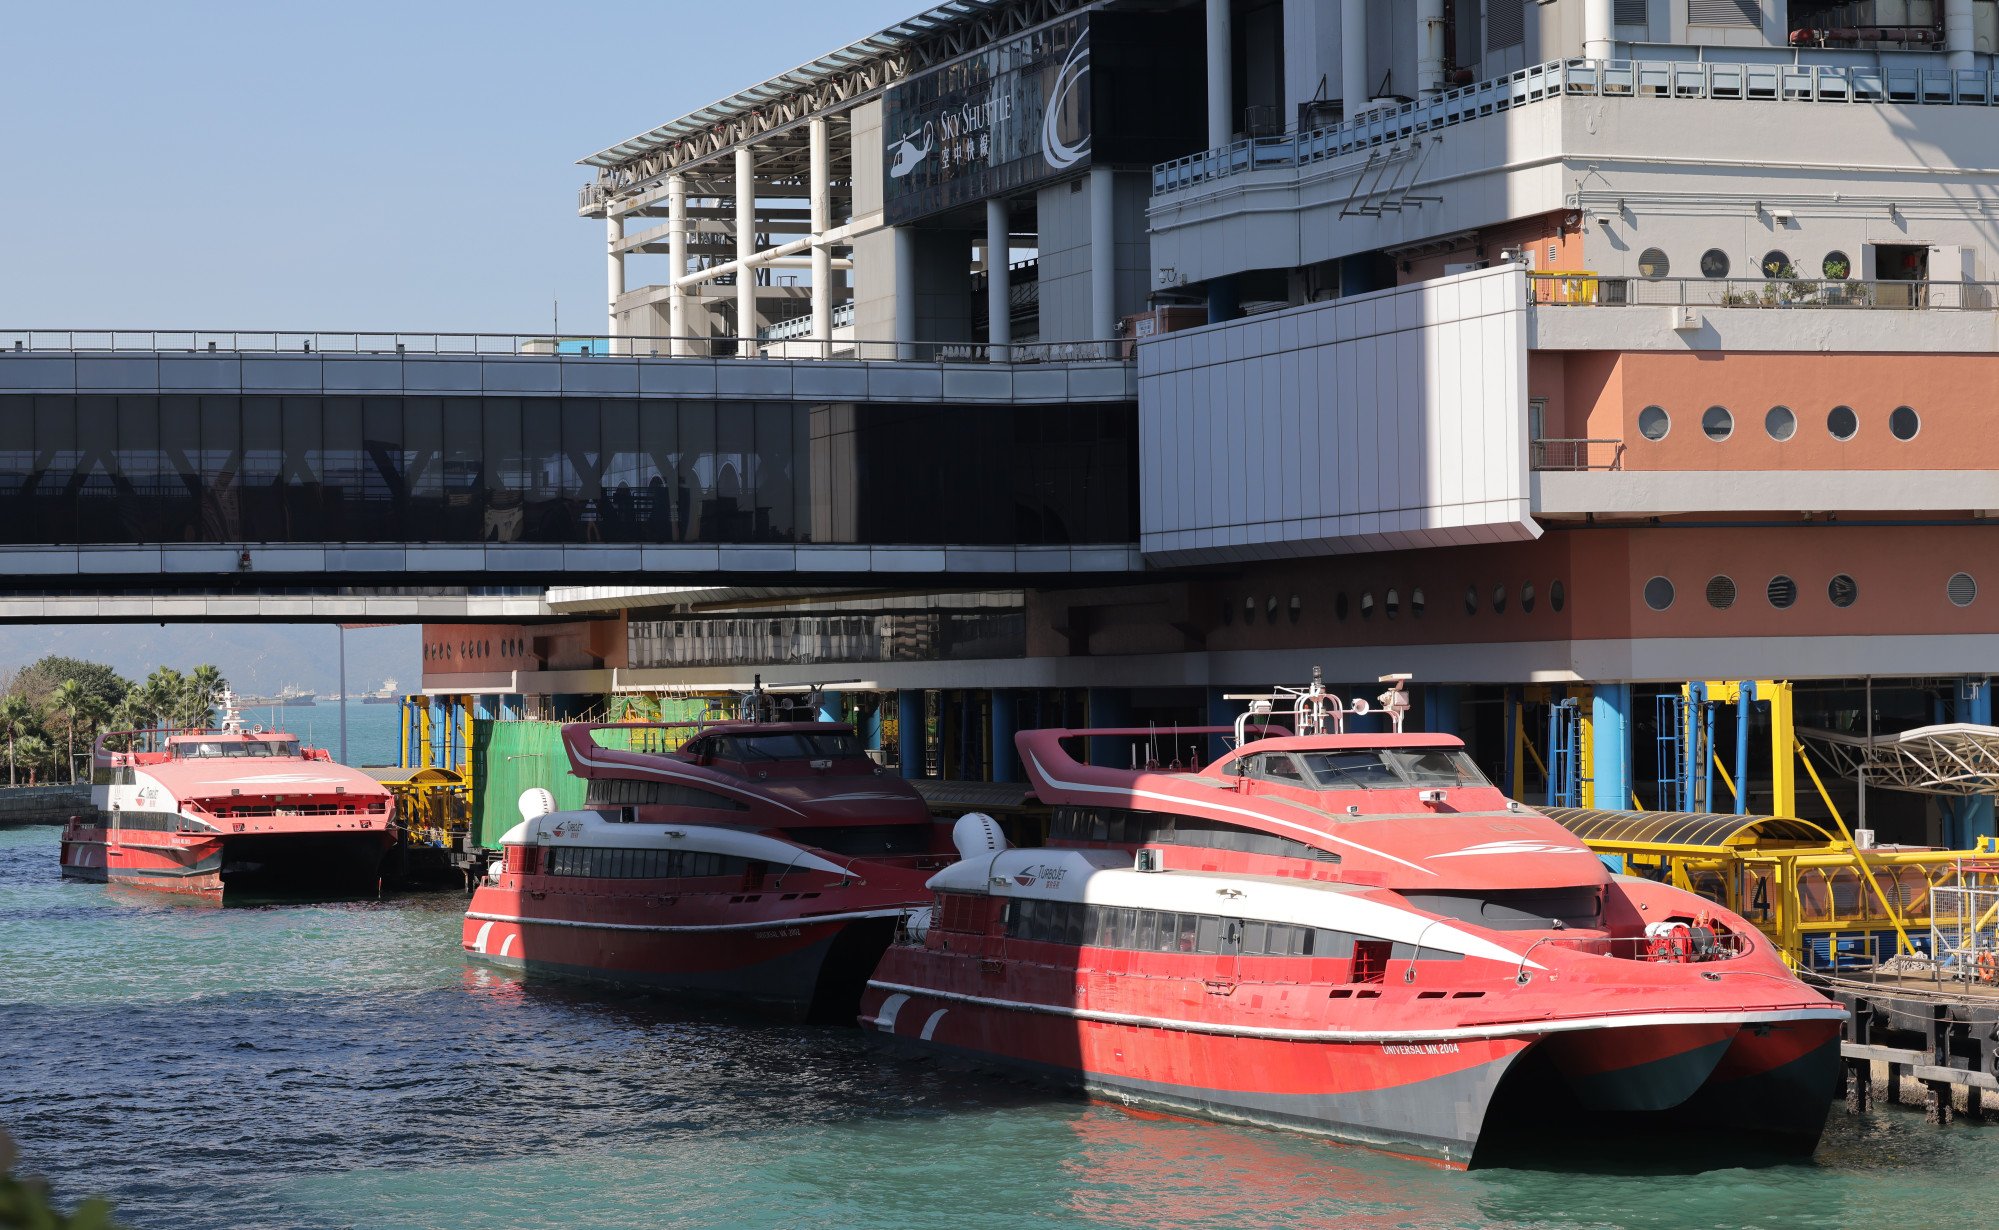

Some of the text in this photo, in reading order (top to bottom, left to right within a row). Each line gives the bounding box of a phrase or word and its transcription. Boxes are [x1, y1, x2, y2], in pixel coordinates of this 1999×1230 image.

[941, 95, 1011, 141] SKY SHUTTLE
[1753, 876, 1770, 922] 4
[1382, 1043, 1459, 1055] UNIVERSAL MK 2004
